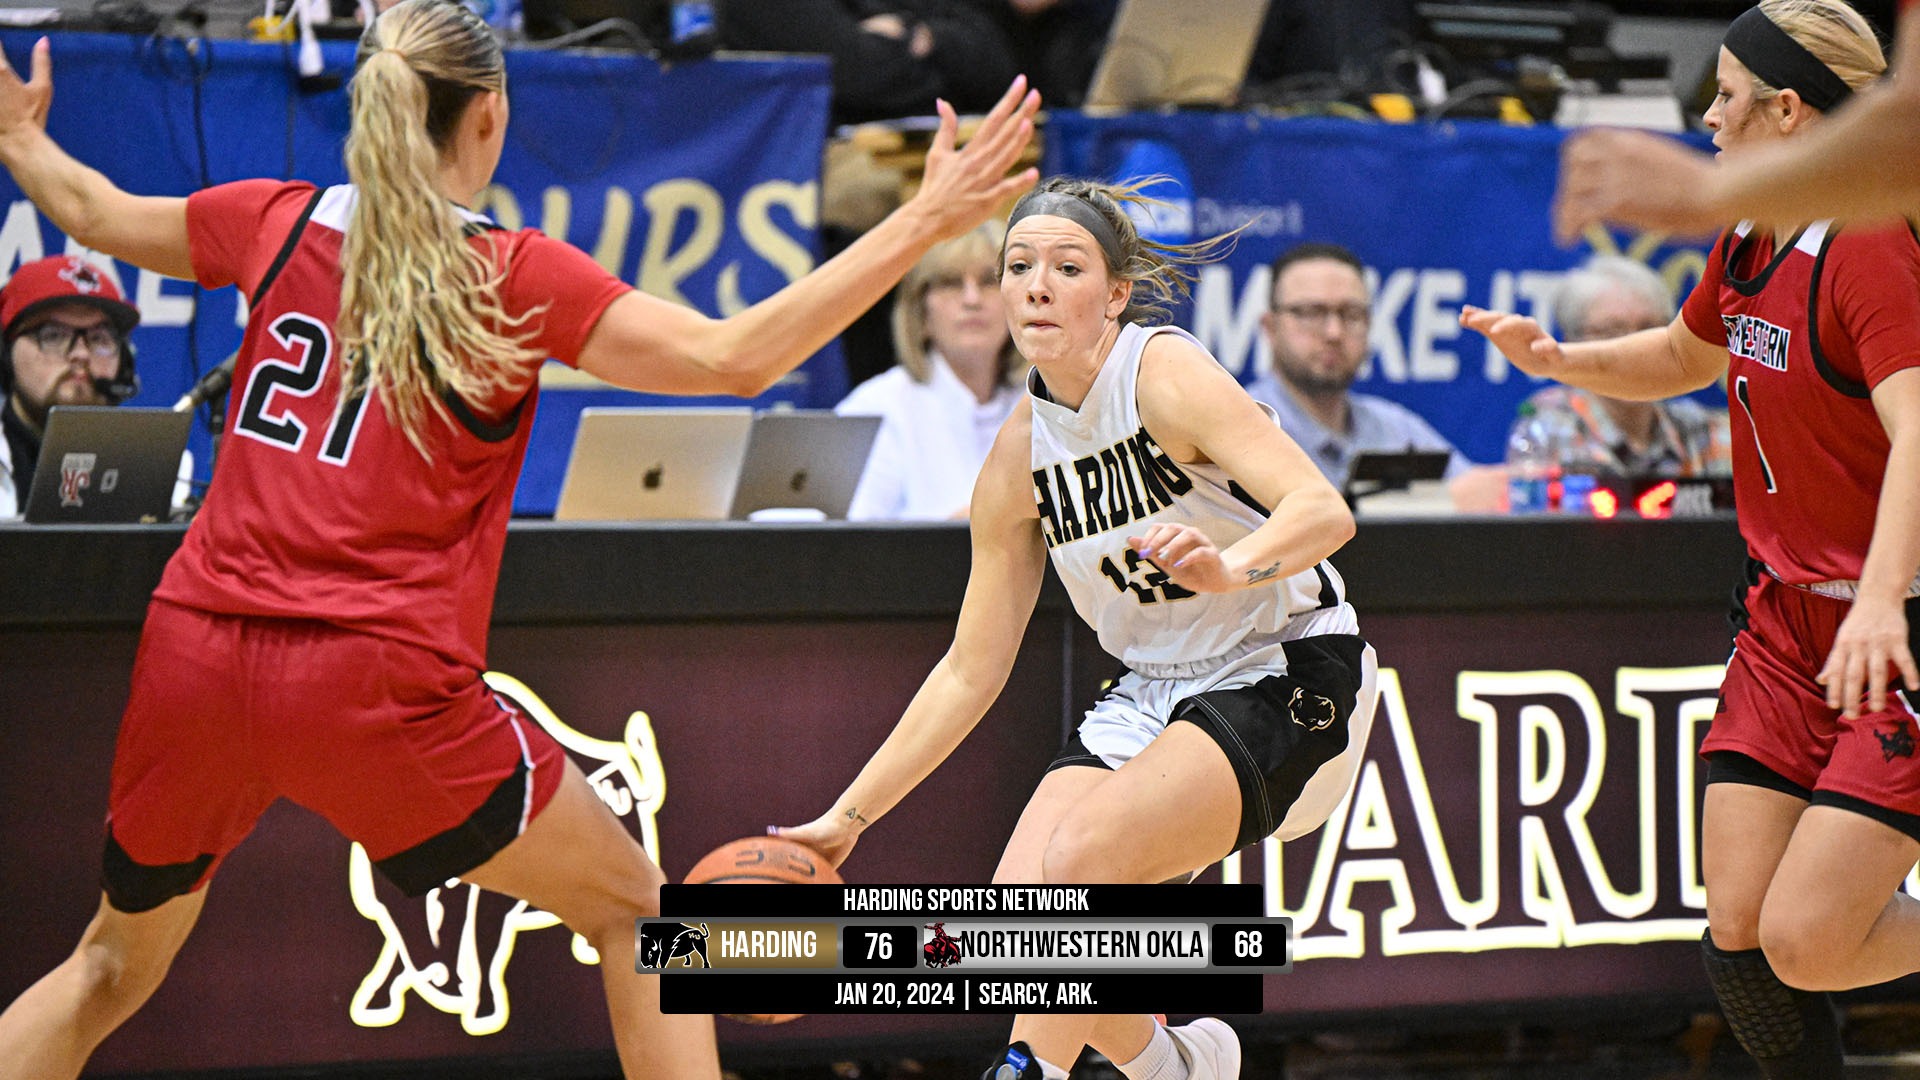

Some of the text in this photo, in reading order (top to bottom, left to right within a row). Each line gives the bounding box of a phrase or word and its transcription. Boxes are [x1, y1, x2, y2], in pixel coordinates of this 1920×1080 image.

[1193, 262, 1467, 384] MKE
[1031, 426, 1194, 549] HARDING
[1735, 375, 1778, 494] 1
